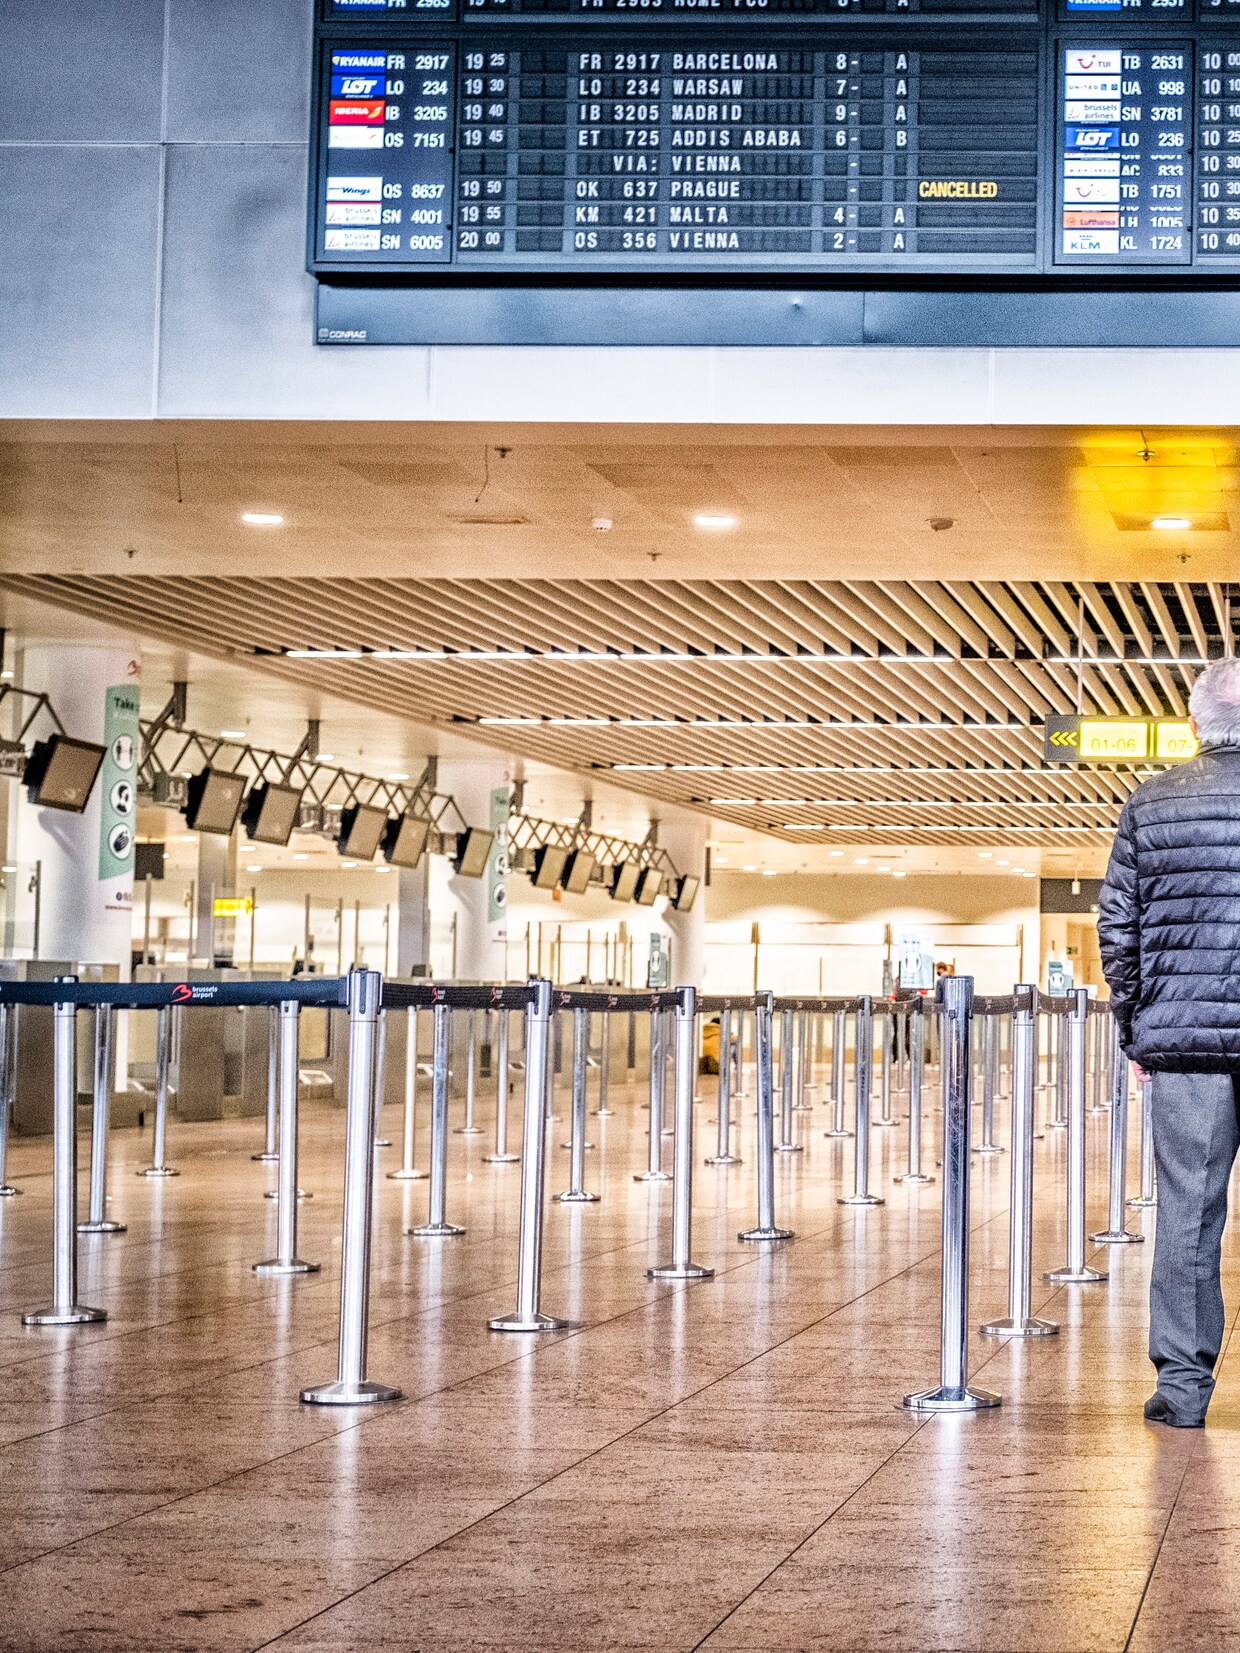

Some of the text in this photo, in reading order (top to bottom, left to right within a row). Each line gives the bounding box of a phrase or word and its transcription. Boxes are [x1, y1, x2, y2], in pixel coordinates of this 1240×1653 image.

[339, 57, 385, 66] RYANAIR
[387, 55, 449, 69] FR 2917
[466, 54, 483, 69] 19
[491, 54, 504, 65] 25
[580, 54, 601, 69] FR
[615, 54, 659, 69] 2917
[674, 54, 777, 69] BARCELONA
[897, 55, 906, 69] A
[1123, 55, 1183, 69] TB 2631
[1204, 54, 1220, 69] 10
[342, 80, 377, 93] LOT
[384, 80, 448, 95] LO 234
[466, 79, 482, 94] 19
[490, 79, 504, 91] 30
[580, 79, 601, 94] LO
[627, 80, 659, 95] 234
[674, 79, 742, 95] WARSAW
[896, 80, 906, 95] A
[1123, 81, 1184, 95] UA 998
[1204, 79, 1220, 94] 10
[386, 106, 447, 120] IB 3205
[465, 105, 482, 119] 19
[489, 105, 503, 116] 40
[581, 105, 600, 120] IB
[615, 105, 658, 120] 3205
[672, 105, 741, 120] MADRID
[896, 106, 906, 120] A
[1120, 107, 1182, 121] SN 3781
[1203, 105, 1220, 120] 10
[383, 133, 444, 147] OS 7151
[465, 130, 481, 145] 19
[489, 130, 503, 142] 45
[579, 130, 600, 145] ET
[626, 131, 659, 145] 725
[672, 130, 729, 146] ADDIS
[743, 131, 800, 146] ABABA
[897, 131, 906, 146] B
[1076, 132, 1112, 145] LOT
[1122, 133, 1184, 147] LO 236
[1202, 130, 1220, 146] 10
[614, 156, 740, 171] VIA: VIENNA
[1202, 156, 1219, 171] 10
[1227, 156, 1240, 168] 30
[342, 186, 371, 195] Wings
[381, 184, 445, 199] QS 8637
[463, 181, 997, 197] 19 50 OK 637 PRAGUE CANCELLED
[1121, 183, 1181, 198] TB 1751
[1202, 182, 1219, 197] 10
[1227, 182, 1240, 194] 30
[380, 208, 401, 224] SN
[411, 209, 442, 224] 4001
[462, 206, 479, 222] 19
[487, 207, 500, 219] 55
[576, 207, 598, 222] KM
[624, 207, 655, 222] 421
[670, 207, 728, 222] MALTA
[894, 208, 907, 223] A
[1079, 216, 1116, 227] Lufthansa
[1202, 208, 1218, 223] 10
[1227, 208, 1240, 220] 35
[380, 235, 400, 249] SN
[410, 235, 443, 250] 6005
[460, 232, 478, 247] 20
[486, 232, 500, 244] 00
[575, 232, 597, 248] OS
[623, 233, 656, 248] 356
[670, 233, 739, 248] VIENNA
[894, 234, 904, 248] A
[1070, 242, 1101, 251] KLM
[1121, 235, 1182, 252] KL 1724
[1201, 234, 1218, 249] 10
[1226, 234, 1240, 246] 40
[1091, 738, 1136, 752] 01-06
